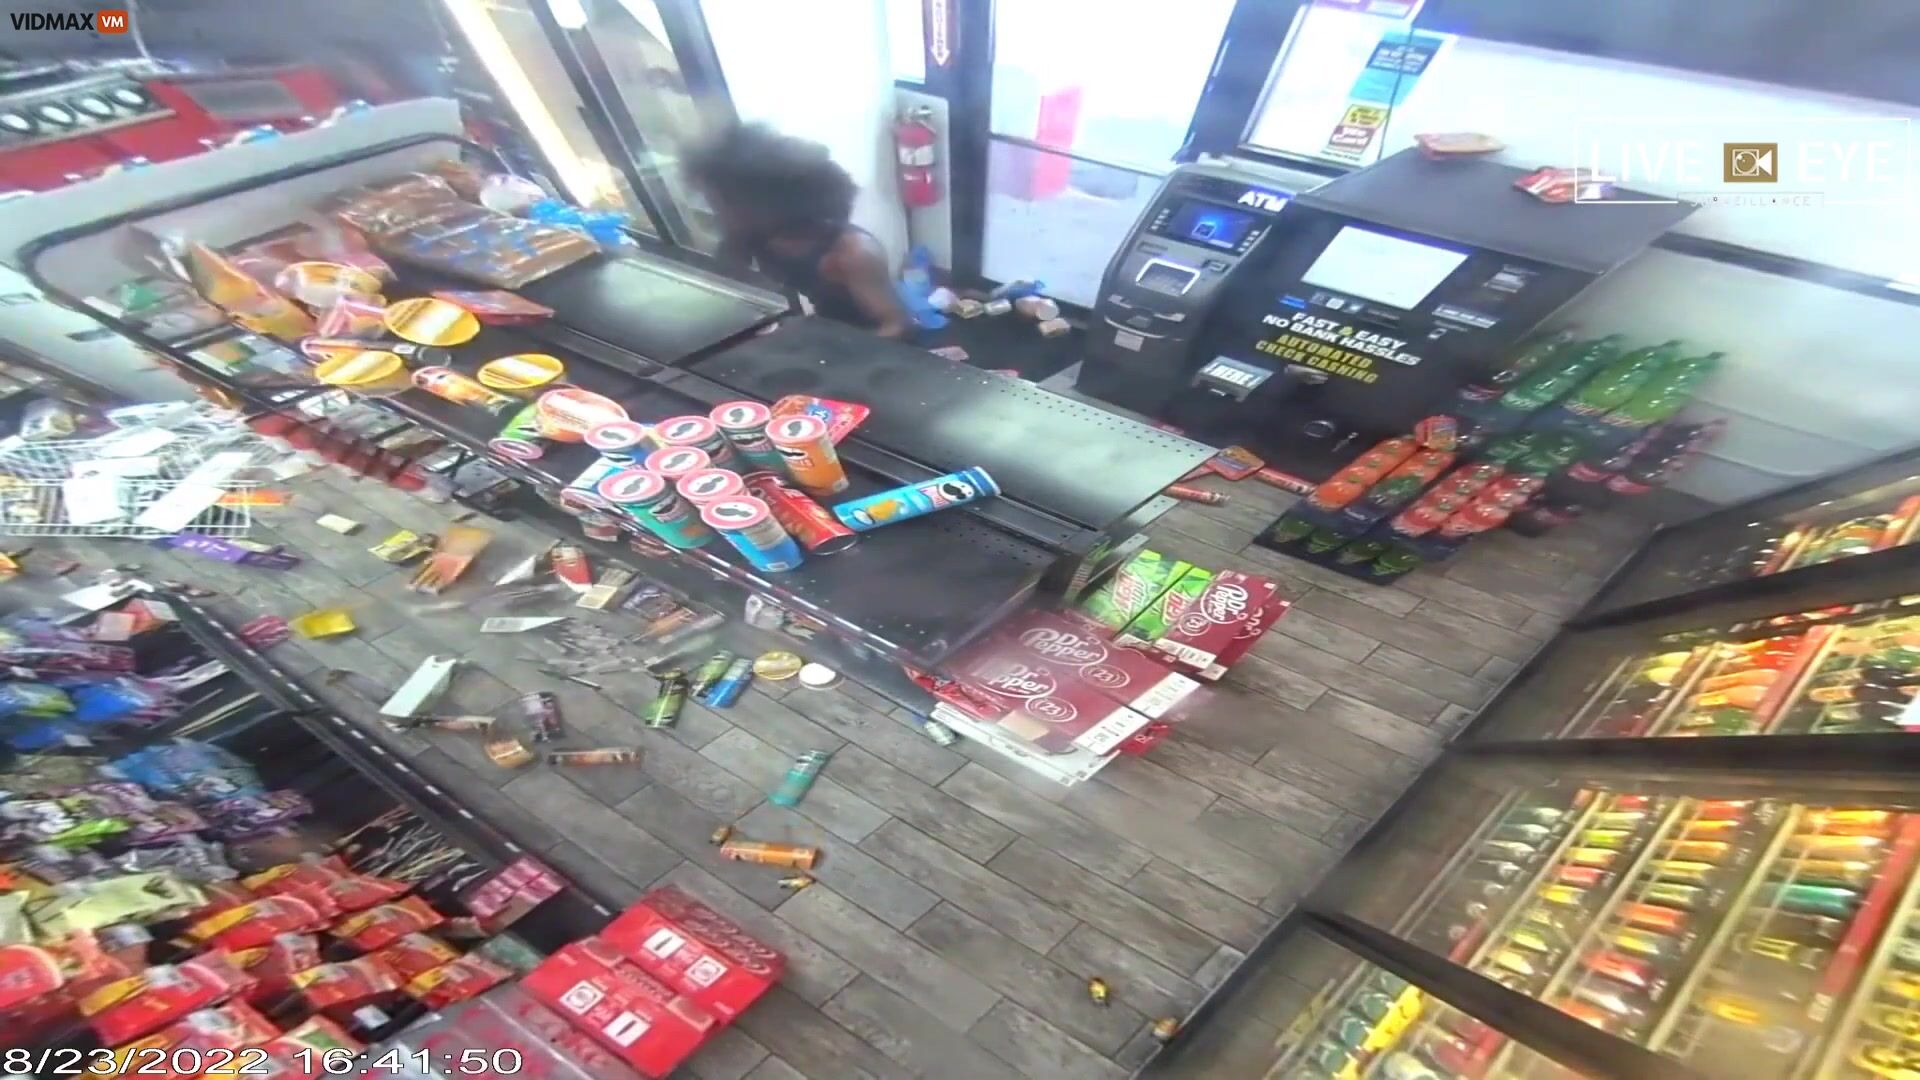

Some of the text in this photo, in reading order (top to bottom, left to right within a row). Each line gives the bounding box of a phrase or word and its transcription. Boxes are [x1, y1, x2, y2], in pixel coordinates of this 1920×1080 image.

[1238, 191, 1288, 212] ATM
[1262, 314, 1422, 366] NO BANK HASSLES
[1292, 312, 1340, 331] FAST
[1355, 330, 1407, 349] EASY
[1255, 339, 1379, 384] CHECK CASHING
[1276, 334, 1373, 369] AUTOMATED
[1210, 585, 1246, 621] Pepper
[1228, 599, 1246, 616] Dr
[1023, 629, 1100, 660] Pepper
[1058, 632, 1088, 648] Dr
[1009, 664, 1038, 679] Dr
[1040, 702, 1061, 716] 23
